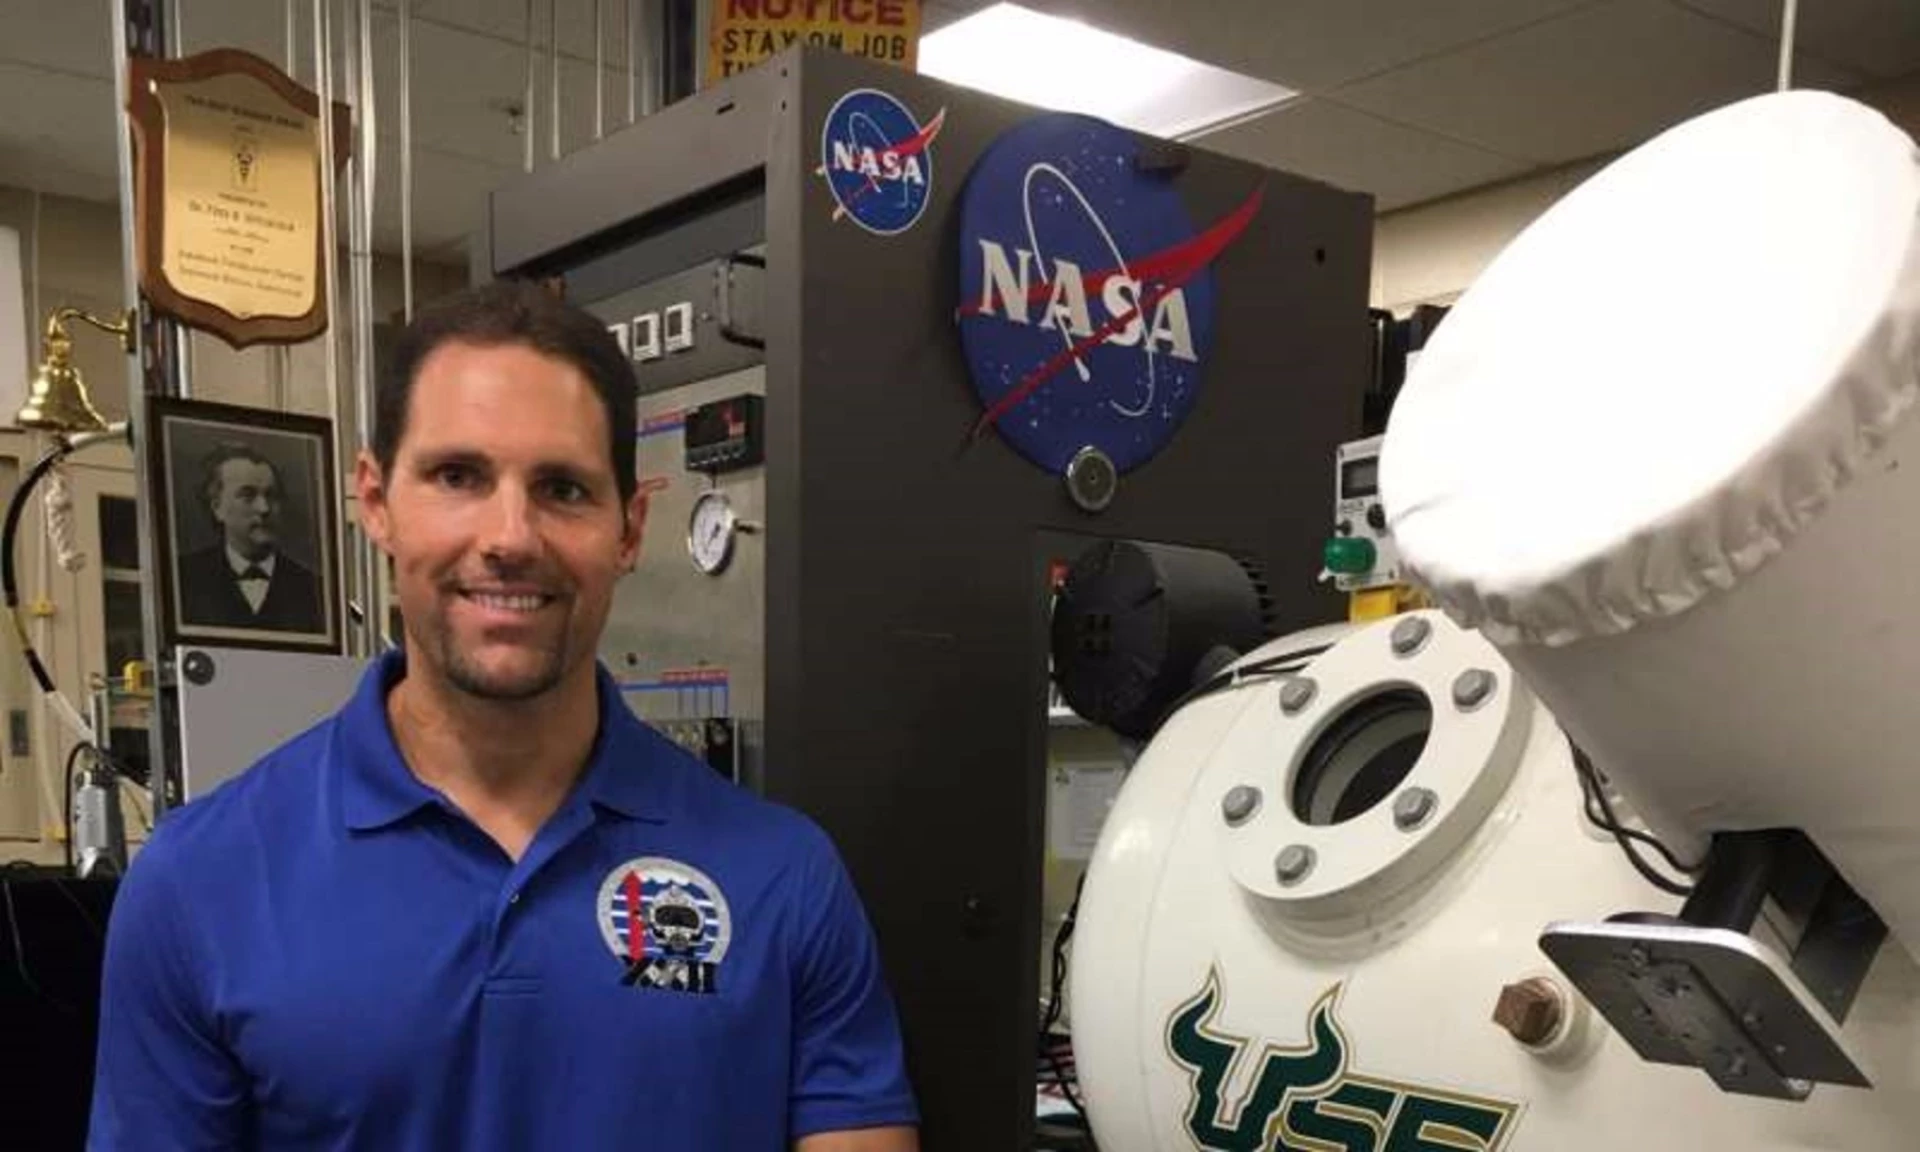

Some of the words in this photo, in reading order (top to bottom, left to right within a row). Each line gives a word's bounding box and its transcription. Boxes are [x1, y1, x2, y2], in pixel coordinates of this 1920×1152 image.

[723, 28, 797, 56] STAY
[854, 32, 907, 60] JOB
[834, 141, 925, 186] NASA
[978, 239, 1198, 363] NASA
[1164, 965, 1520, 1152] USF
